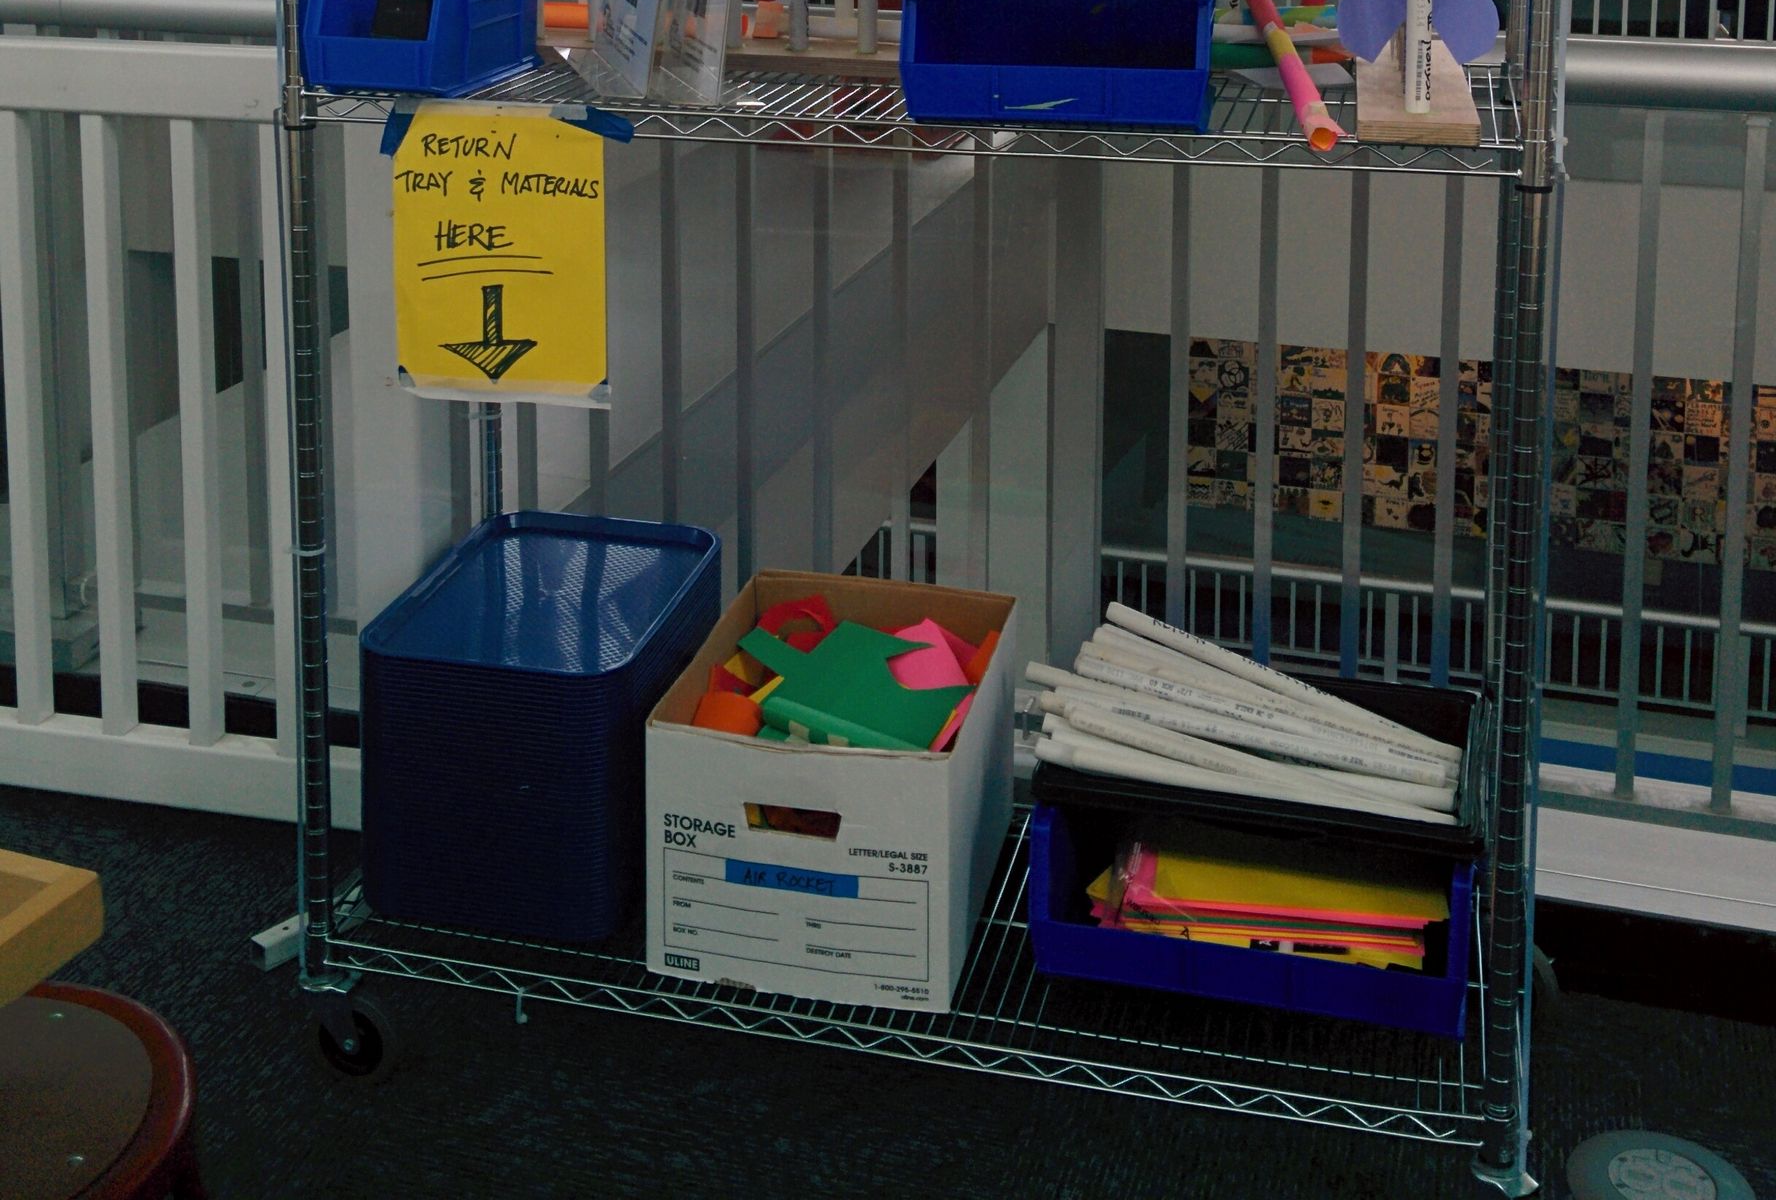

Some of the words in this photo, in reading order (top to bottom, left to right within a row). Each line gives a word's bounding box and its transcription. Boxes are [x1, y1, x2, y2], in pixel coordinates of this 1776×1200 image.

[421, 132, 516, 160] RETURN
[394, 170, 453, 198] TRAY
[468, 169, 486, 202] &
[500, 171, 599, 199] MATERIALS
[434, 220, 514, 251] HERE
[664, 813, 736, 838] STORAGE
[664, 830, 697, 849] BOX
[848, 847, 908, 860] LETTER/LEGAL
[910, 852, 928, 862] SIZE
[888, 862, 928, 876] S-3887
[672, 874, 704, 886] CONTENTS
[743, 867, 768, 883] AIR
[776, 873, 836, 896] ROCKET
[672, 900, 692, 910] FROM
[672, 926, 686, 936] BOX
[806, 947, 834, 958] DESTROY
[835, 950, 852, 960] DATE
[667, 956, 698, 970] ULINE
